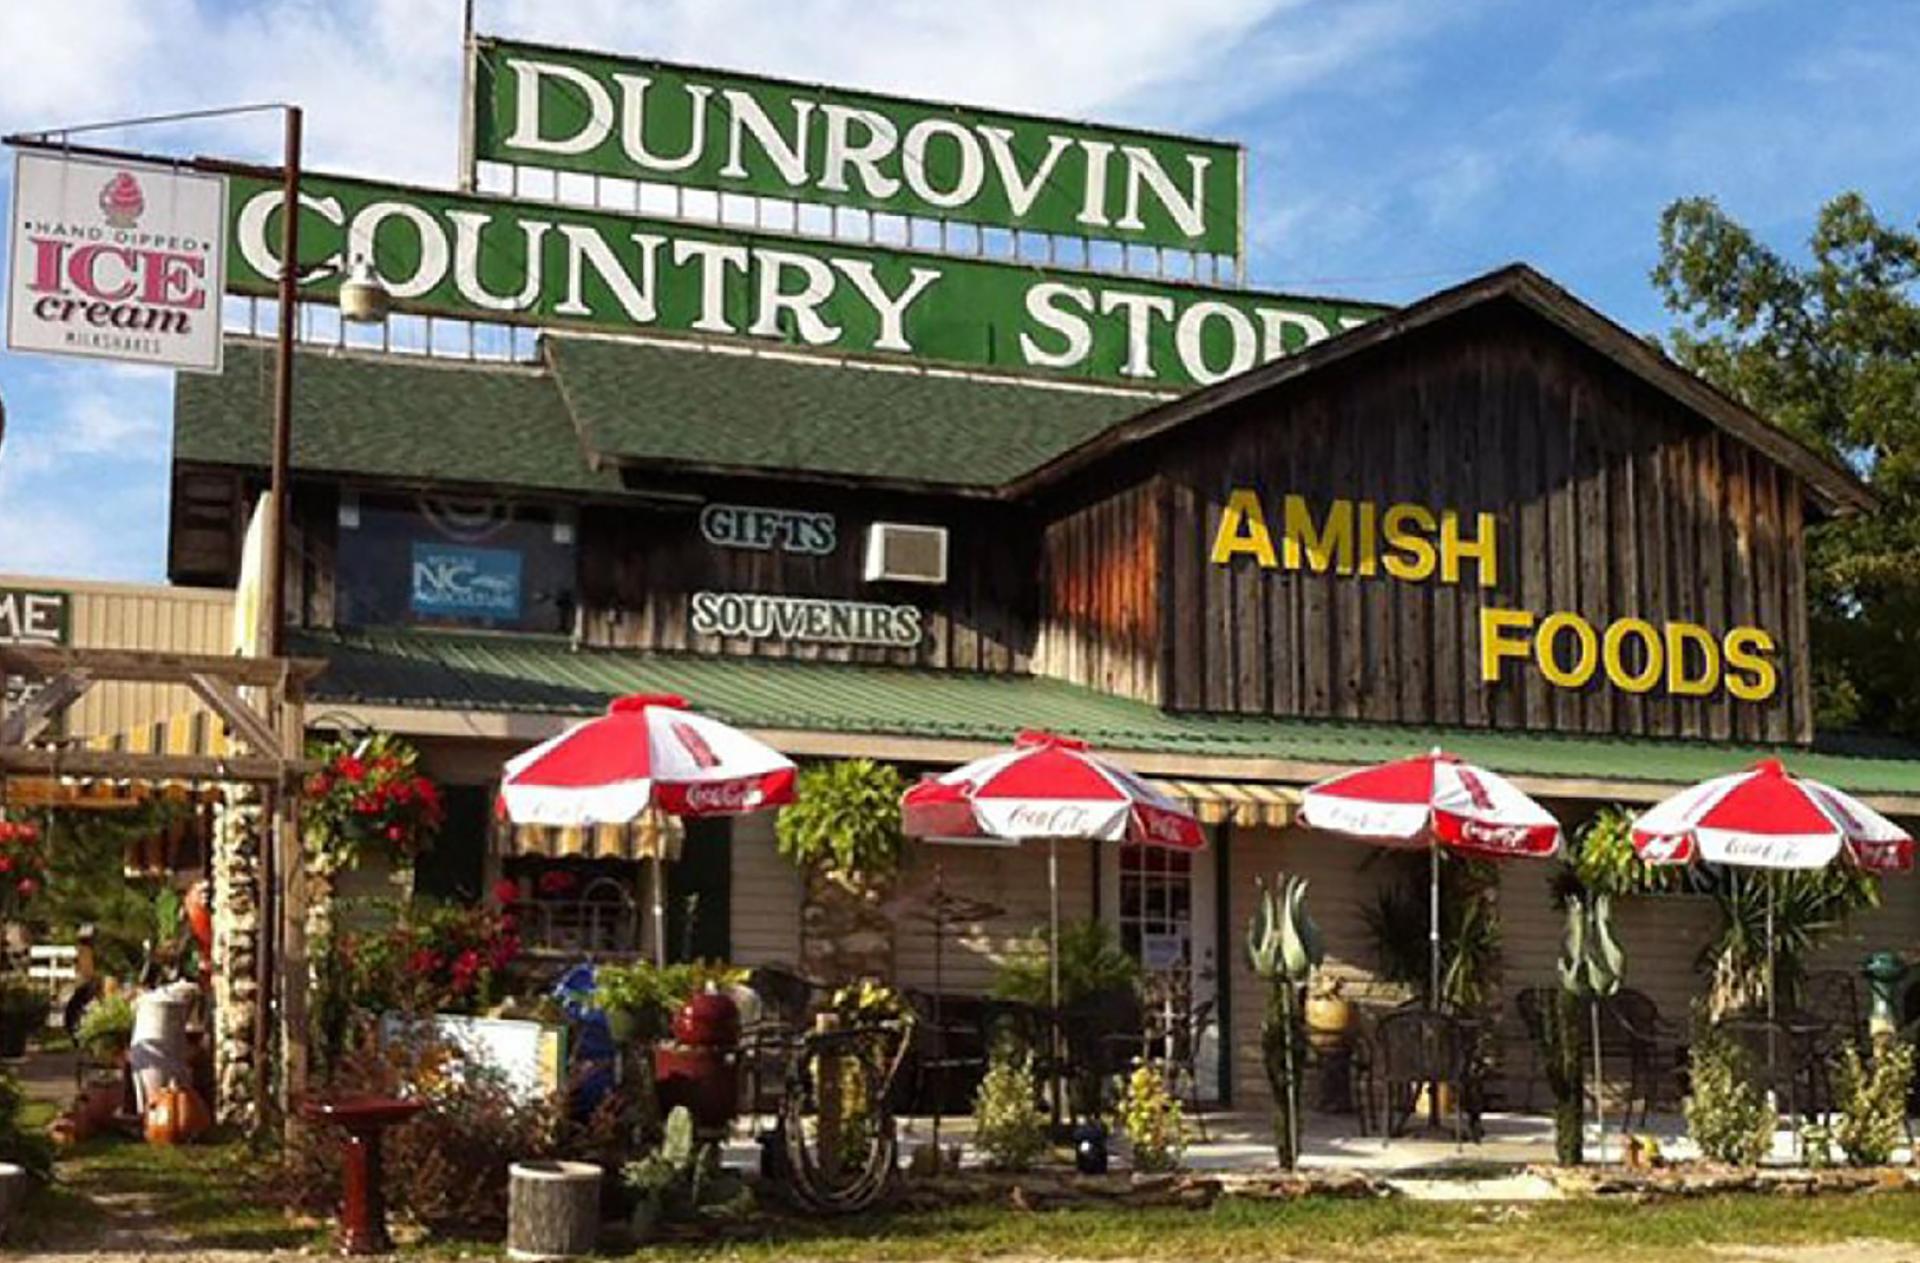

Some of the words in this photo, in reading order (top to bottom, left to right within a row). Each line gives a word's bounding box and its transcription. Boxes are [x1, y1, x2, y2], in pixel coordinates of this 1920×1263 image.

[504, 58, 1212, 238] DUNROVIN
[27, 236, 206, 310] ICE
[36, 221, 102, 241] HAND
[114, 231, 198, 251] DIPPED
[33, 296, 191, 334] cream
[237, 188, 942, 352] COUNTRY
[1020, 281, 1367, 385] STOR
[702, 505, 835, 553] GIFTS
[1210, 489, 1497, 588] AMISH
[693, 592, 922, 646] SOUVENIRS
[1480, 606, 1777, 701] FOODS
